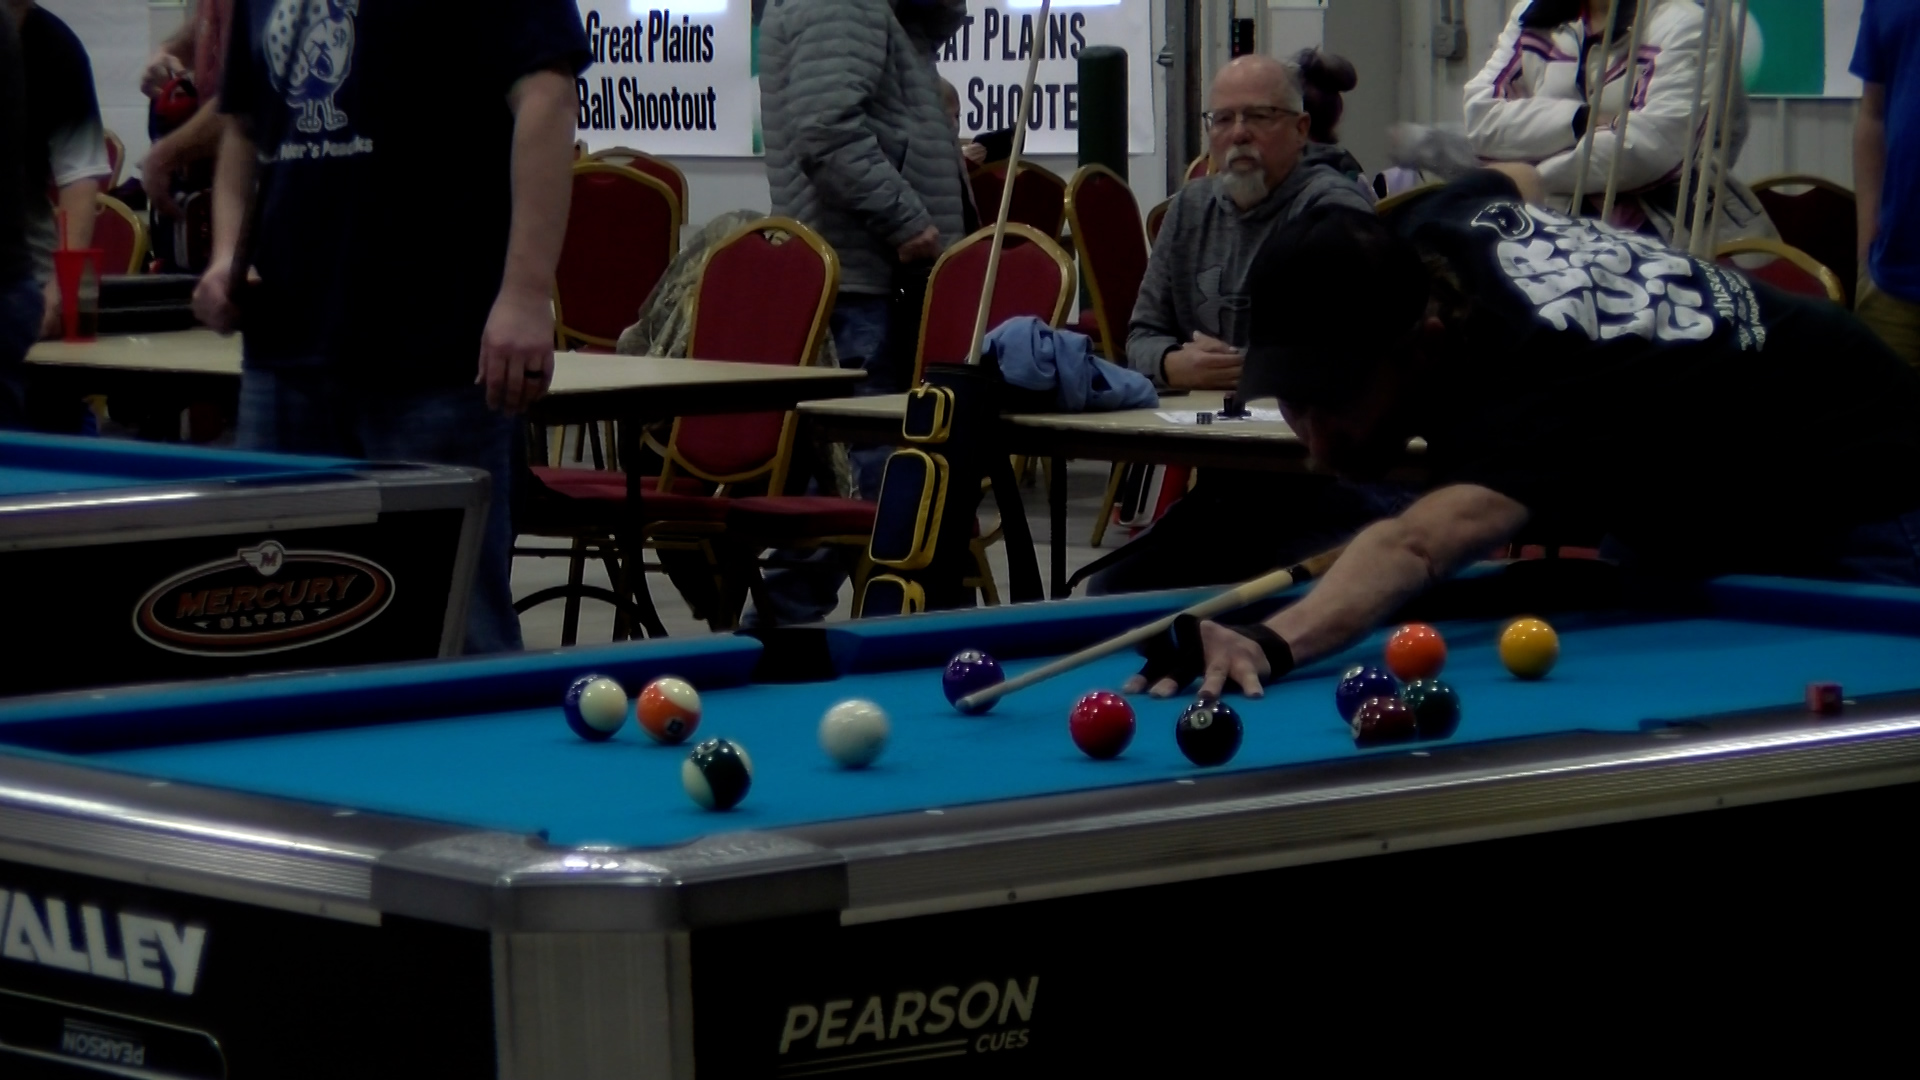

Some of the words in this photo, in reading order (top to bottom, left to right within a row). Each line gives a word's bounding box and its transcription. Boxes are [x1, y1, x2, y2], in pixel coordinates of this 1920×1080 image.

[586, 10, 643, 63] Great
[647, 9, 714, 63] Plains
[576, 77, 616, 130] Ball
[618, 76, 717, 131] Shootout
[967, 76, 1079, 131] SHOOTE
[175, 573, 359, 619] MERCURY
[218, 608, 305, 630] ULTRA
[0, 886, 207, 996] ALLEY
[777, 975, 1040, 1055] PEARSON
[975, 1028, 1030, 1054] CUES
[62, 1030, 147, 1067] PEARSON
